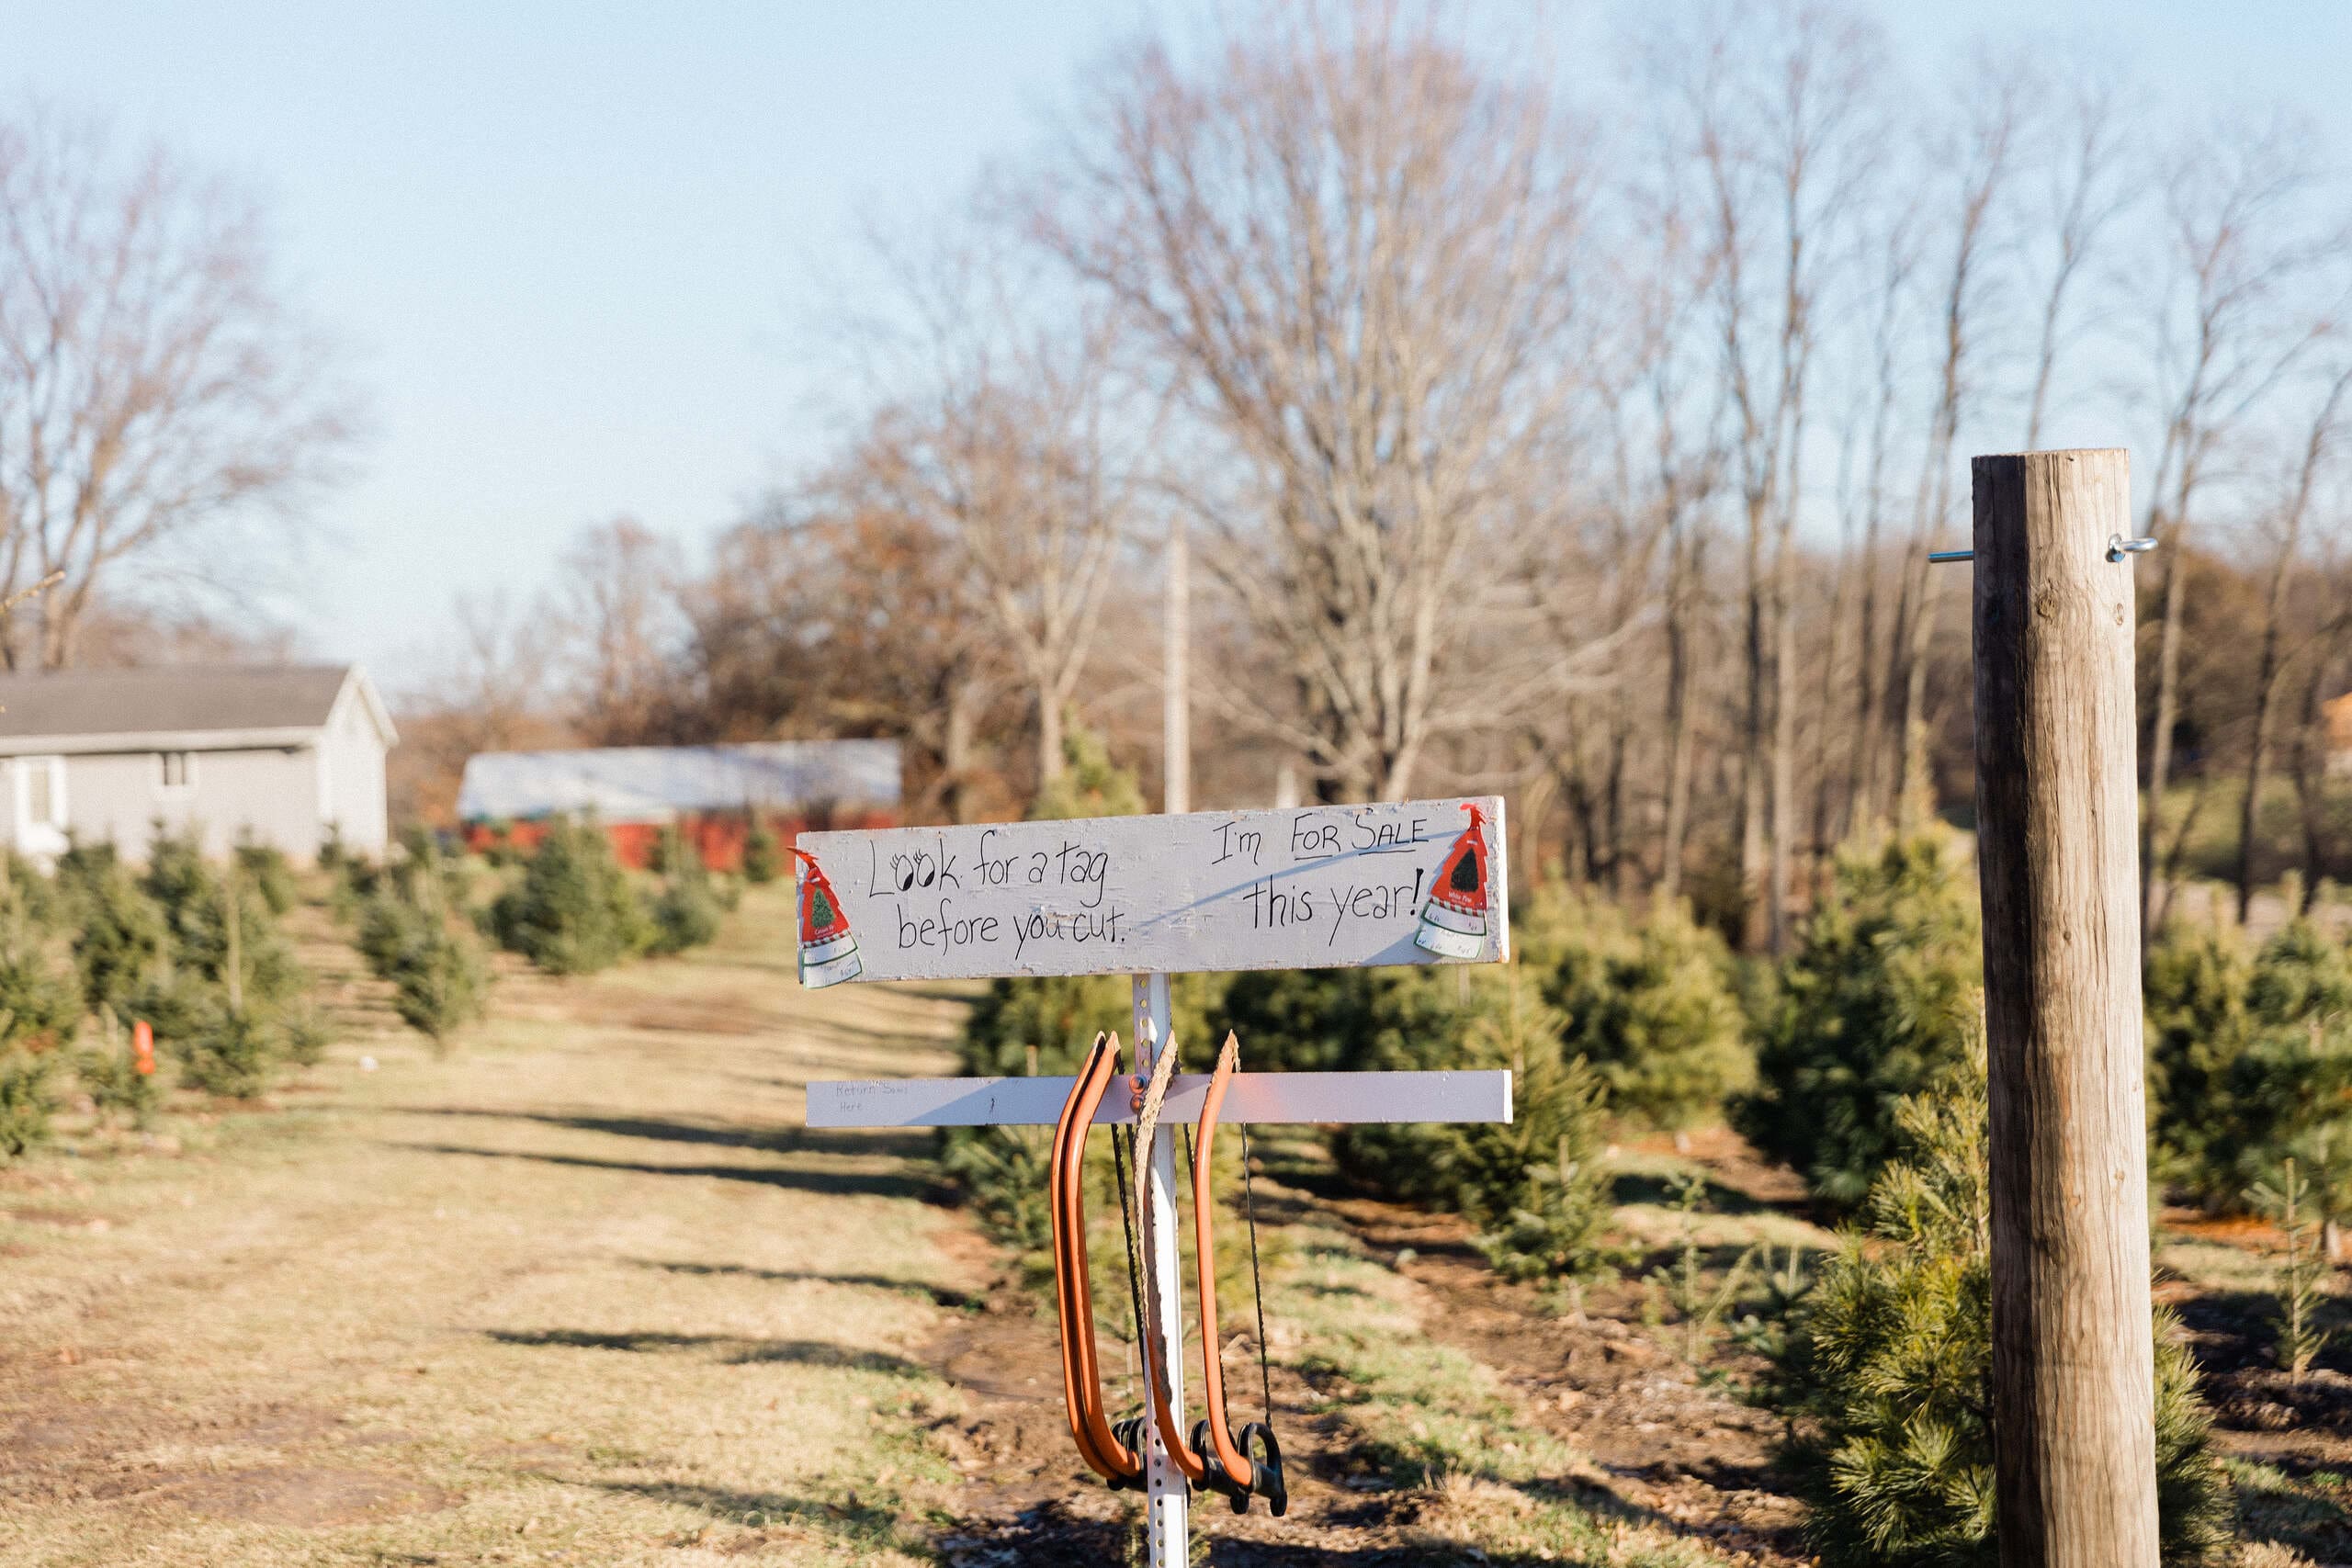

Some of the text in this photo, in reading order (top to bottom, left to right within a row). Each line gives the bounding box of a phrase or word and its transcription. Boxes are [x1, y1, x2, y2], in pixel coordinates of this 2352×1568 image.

[1291, 812, 1341, 852] FOR
[1351, 814, 1429, 852] SALE
[869, 829, 1109, 908] Look for a tag
[897, 897, 1125, 960] before you cut.
[1243, 867, 1424, 946] this year!
